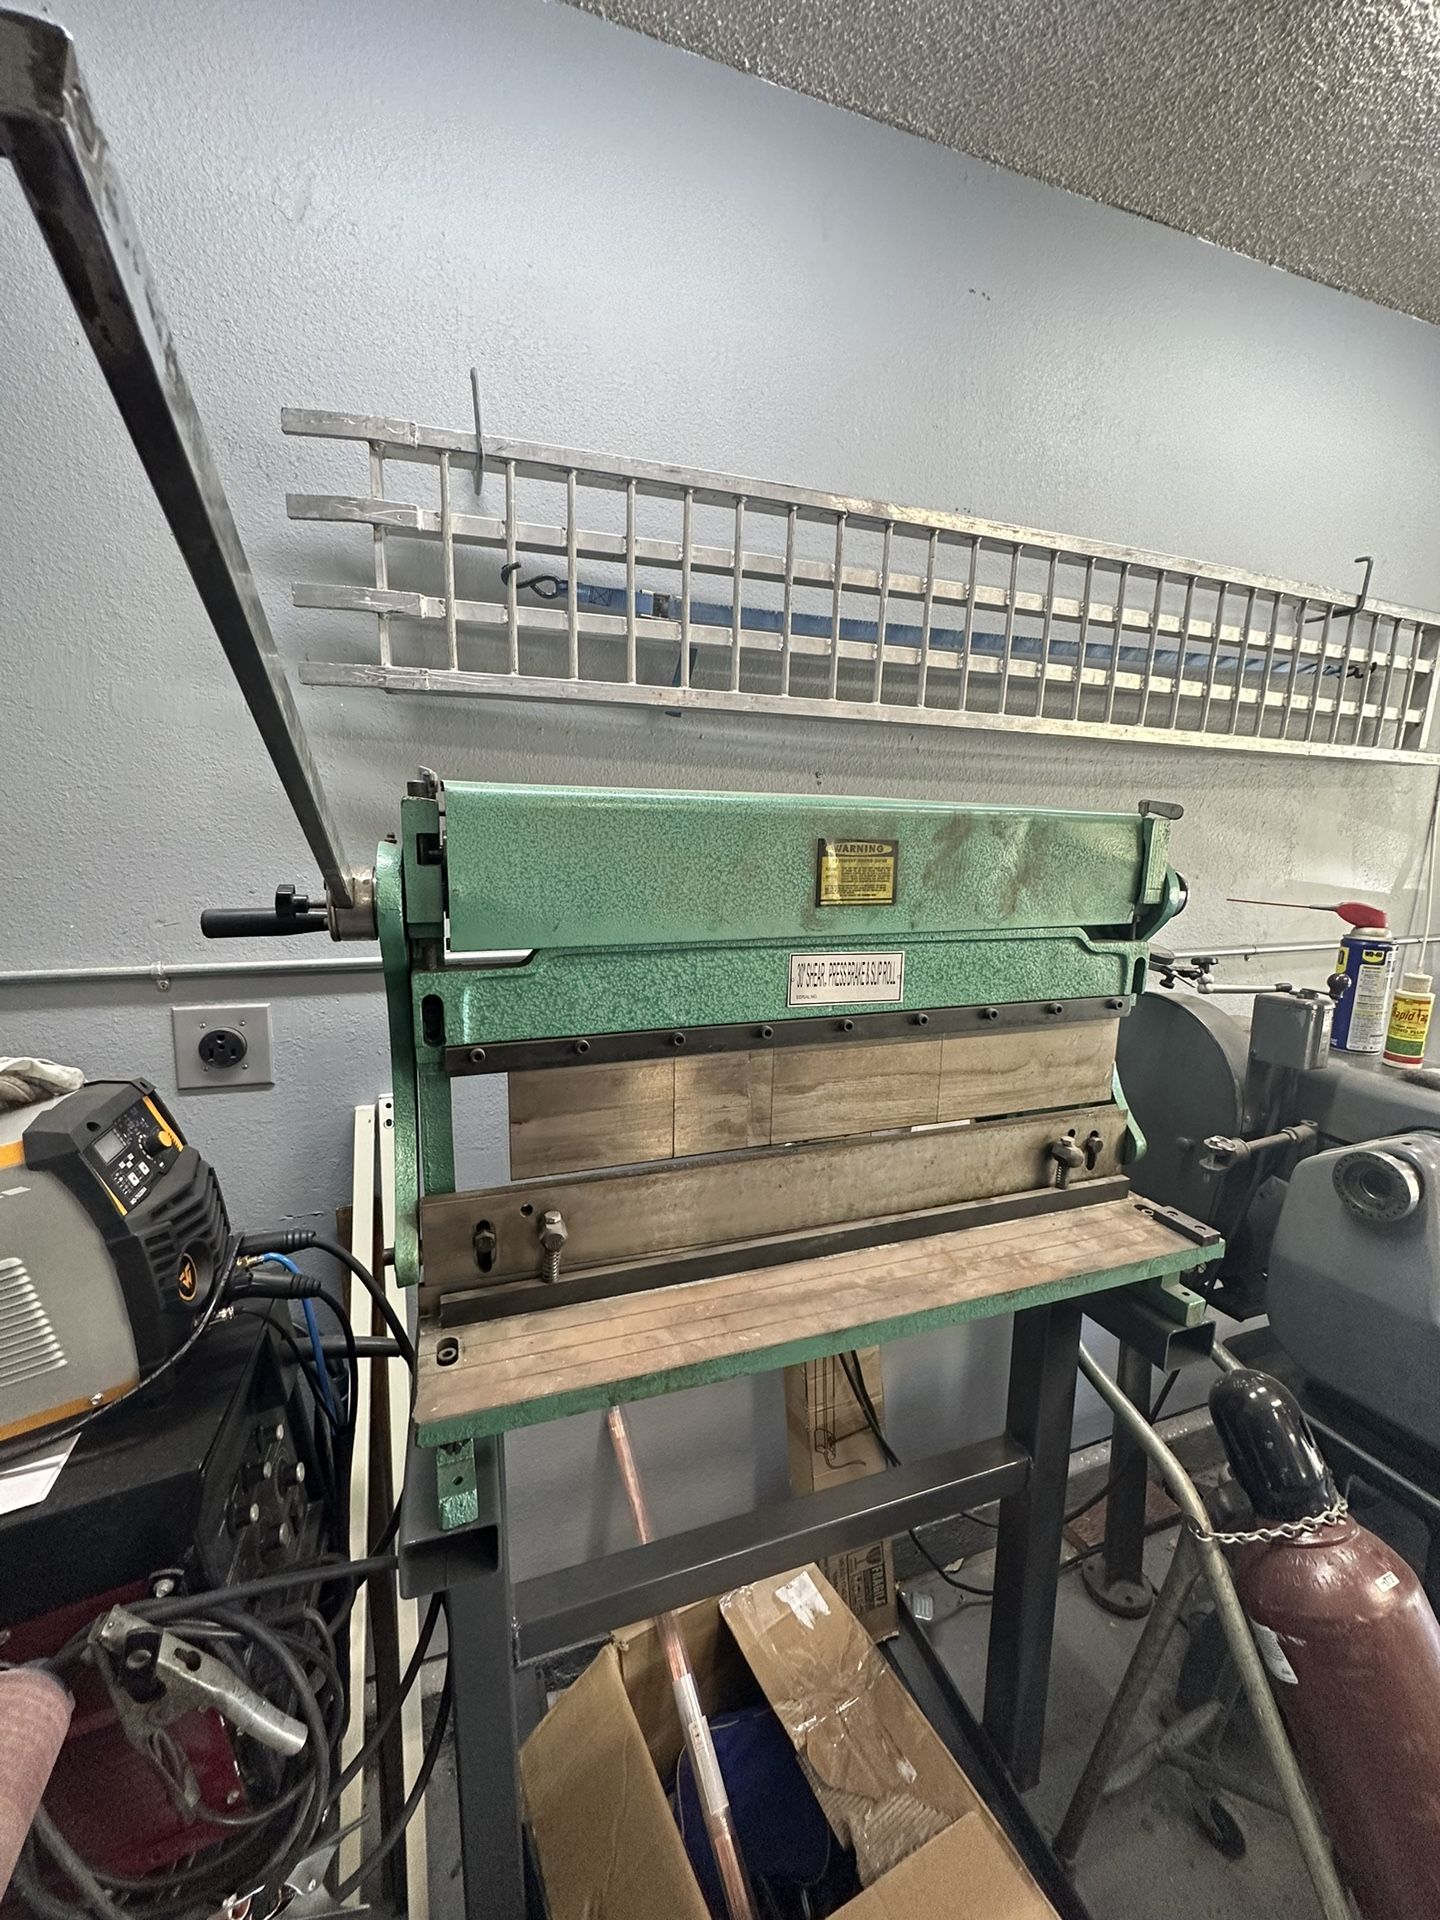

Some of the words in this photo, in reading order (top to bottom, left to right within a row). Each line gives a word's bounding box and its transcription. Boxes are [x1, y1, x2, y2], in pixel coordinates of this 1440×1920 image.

[835, 844, 884, 853] WARNING
[828, 962, 847, 986] PRESS
[847, 961, 866, 986] BRAKE
[883, 961, 896, 985] ROLL
[871, 1566, 886, 1607] FRAGILE
